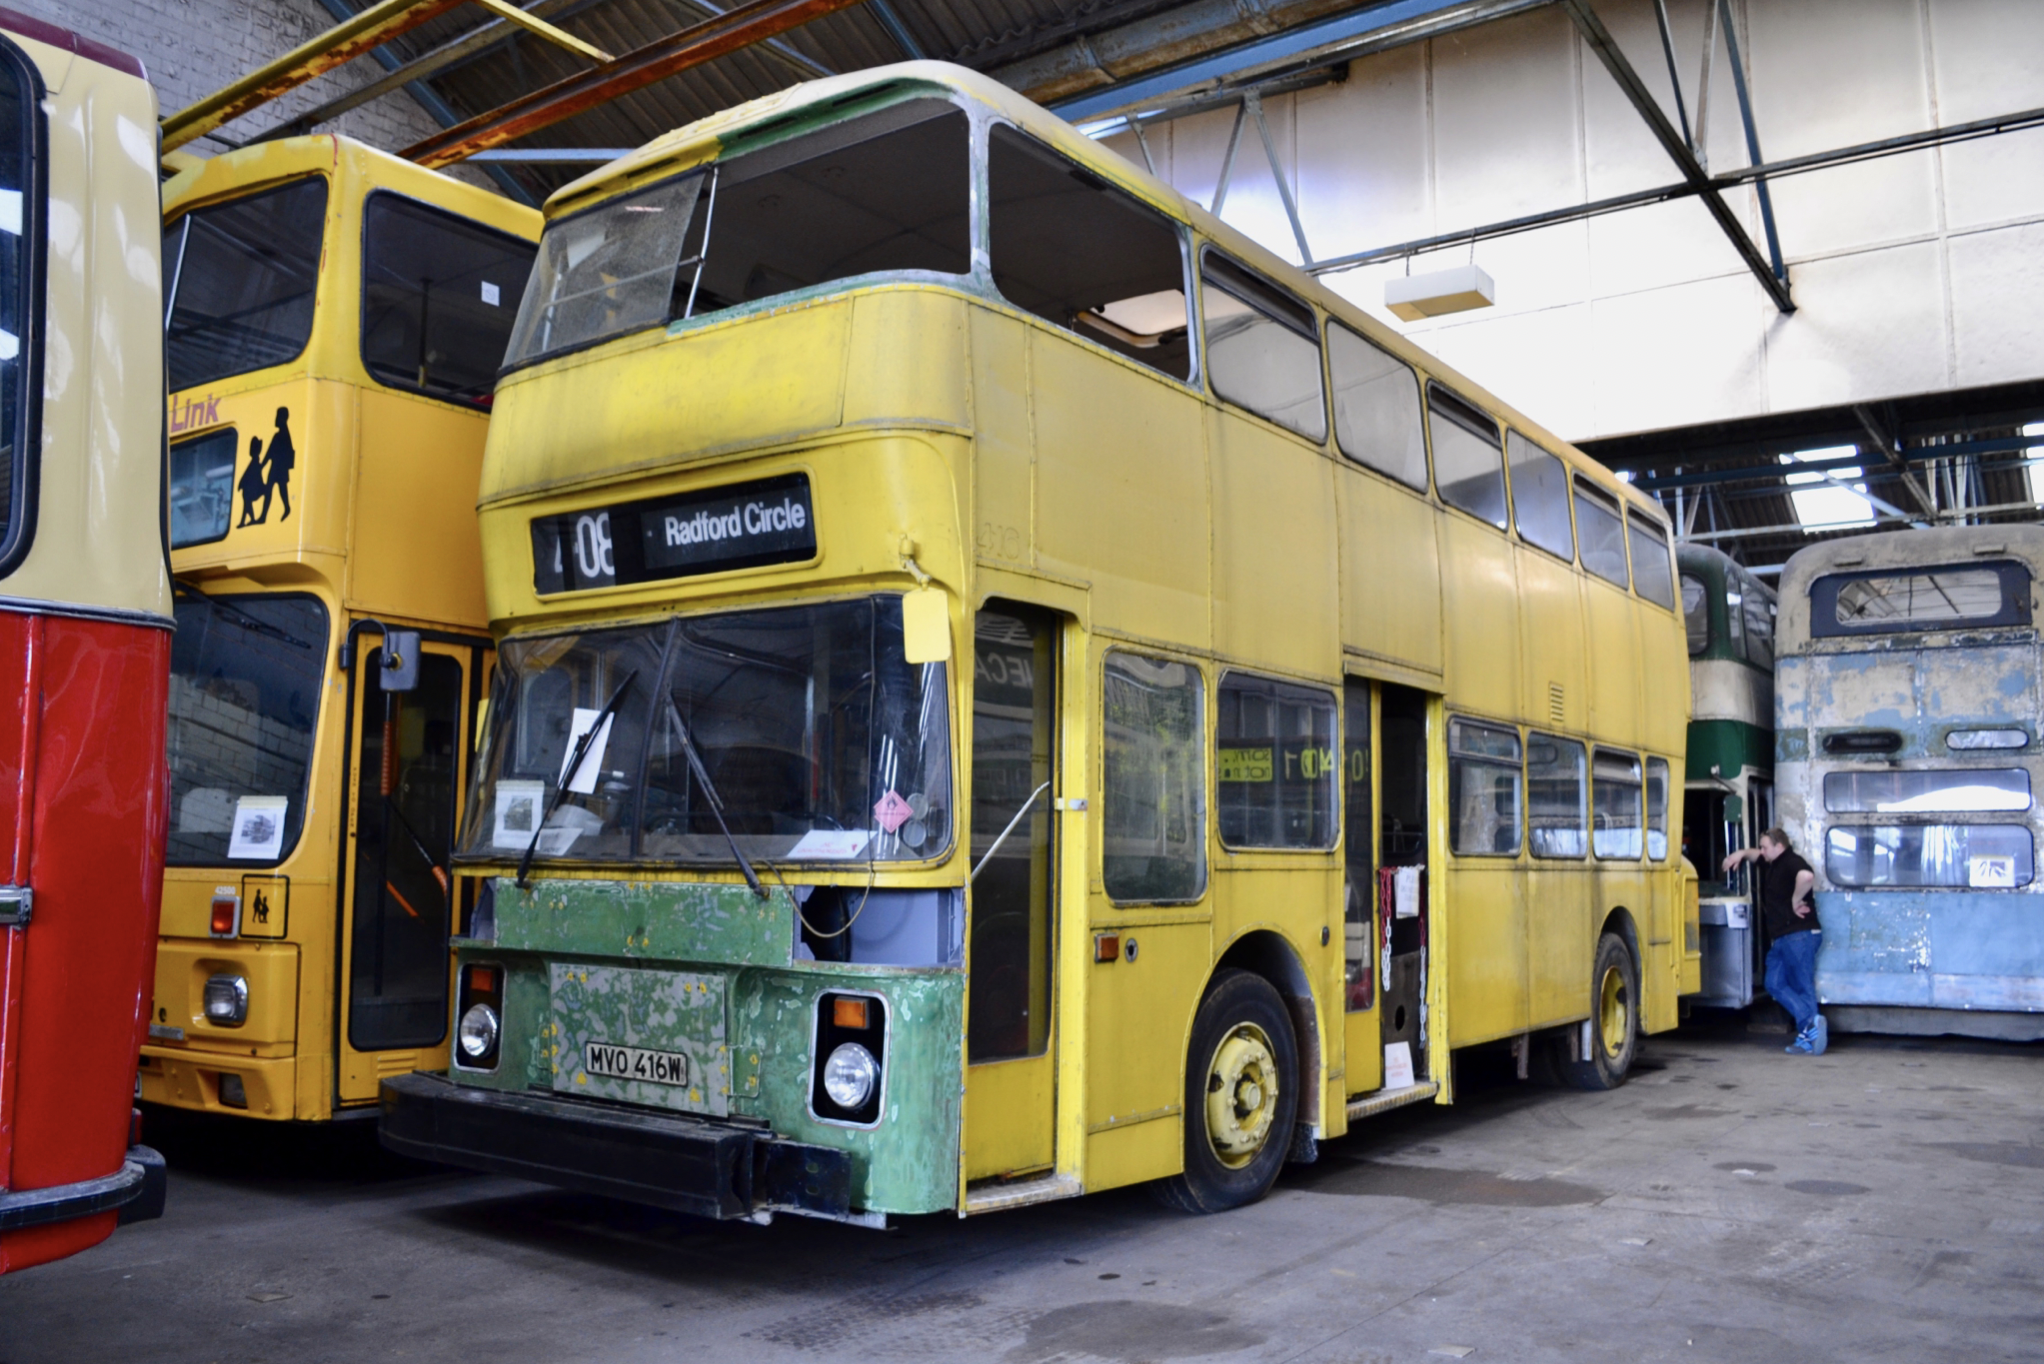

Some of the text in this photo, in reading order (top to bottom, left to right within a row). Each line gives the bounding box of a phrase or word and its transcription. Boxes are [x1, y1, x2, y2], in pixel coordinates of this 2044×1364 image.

[171, 393, 221, 432] Link
[664, 506, 742, 547] Radford
[743, 497, 806, 536] Circle
[591, 1046, 681, 1082] MVO 416W
